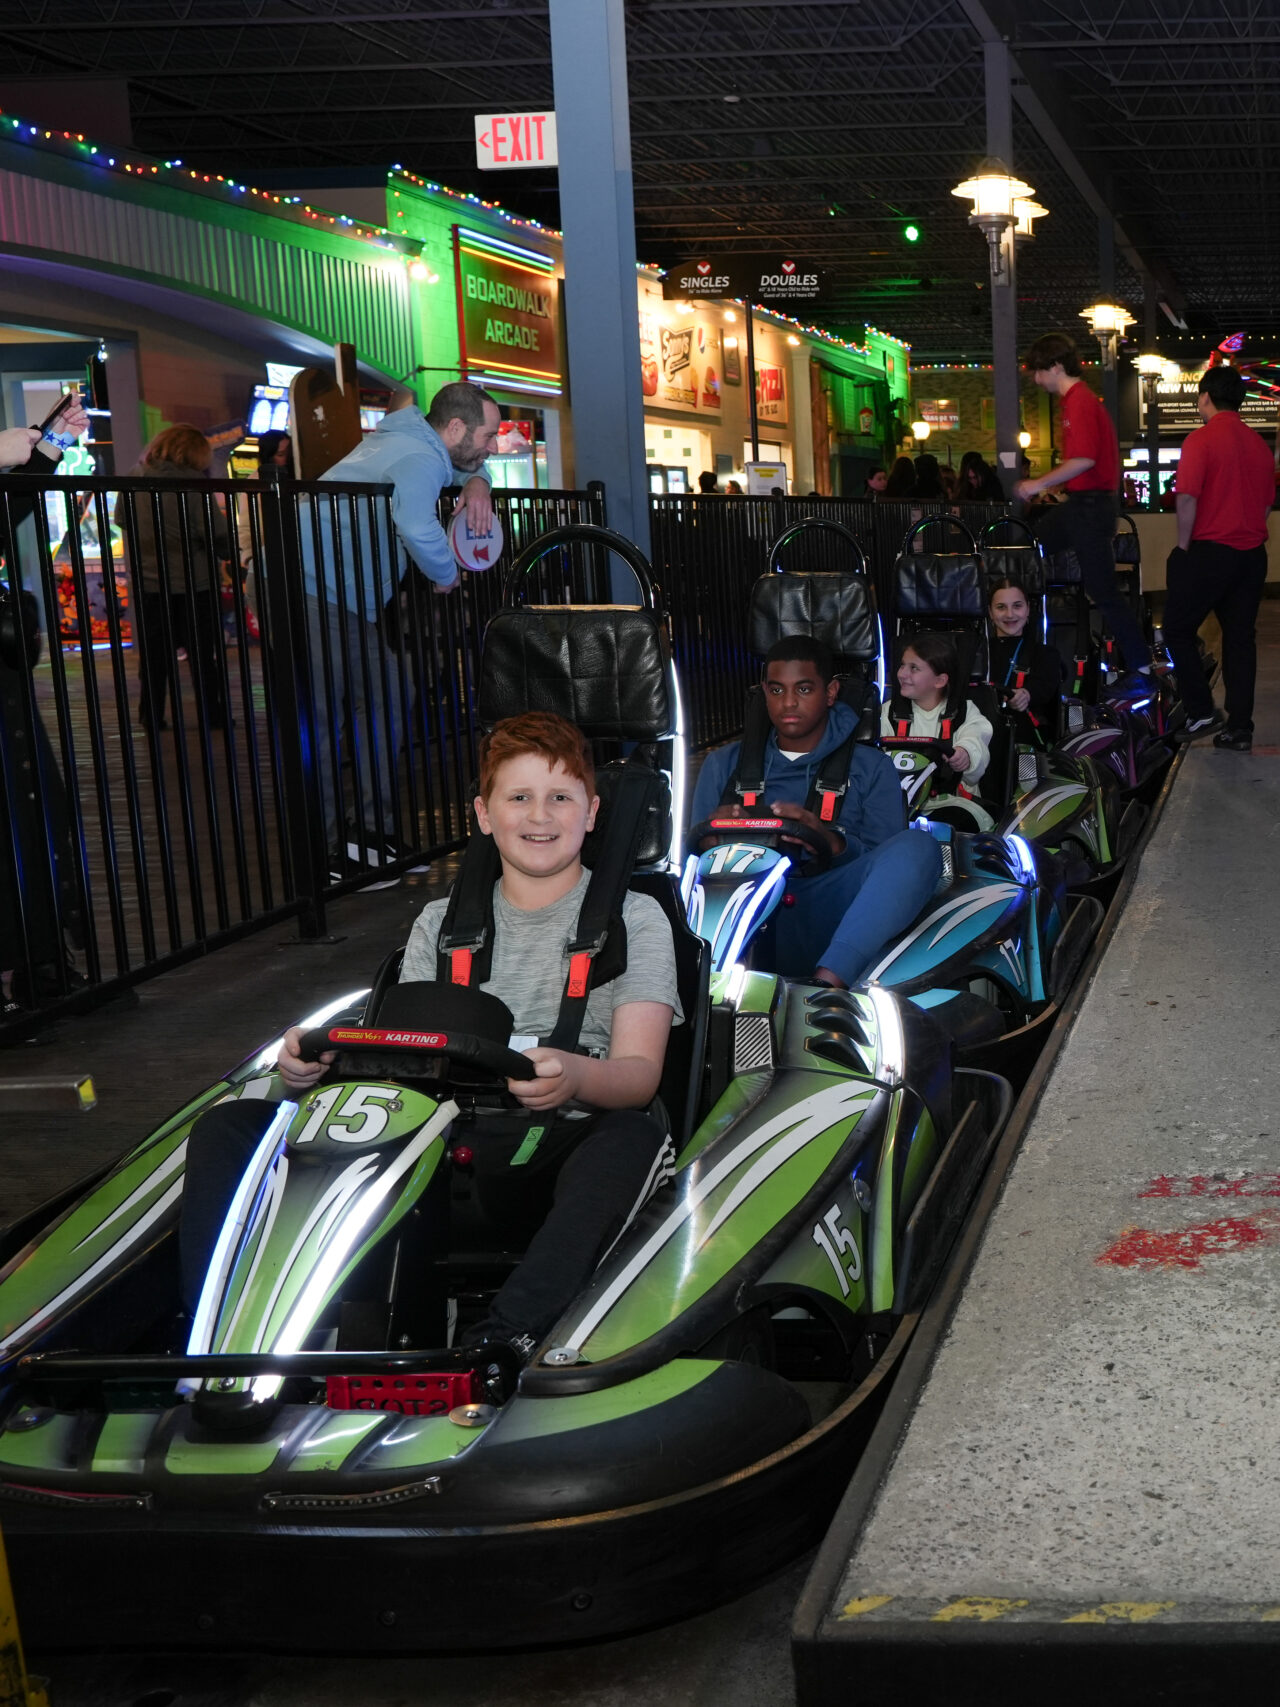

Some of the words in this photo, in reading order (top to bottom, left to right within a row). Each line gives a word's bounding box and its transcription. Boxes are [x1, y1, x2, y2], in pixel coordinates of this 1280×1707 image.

[491, 115, 547, 163] EXIT
[466, 273, 551, 319] BOARDWALK
[680, 276, 730, 289] SINGLES
[760, 275, 818, 287] DOUBLES
[484, 318, 540, 352] ARCADE
[1157, 383, 1181, 394] NEW
[1183, 383, 1199, 393] WA
[885, 751, 915, 771] 6
[709, 845, 766, 875] 17
[999, 937, 1025, 987] 17
[336, 1031, 364, 1040] THUNDER
[385, 1033, 439, 1044] KARTING
[295, 1085, 402, 1144] 15
[812, 1203, 862, 1298] 15
